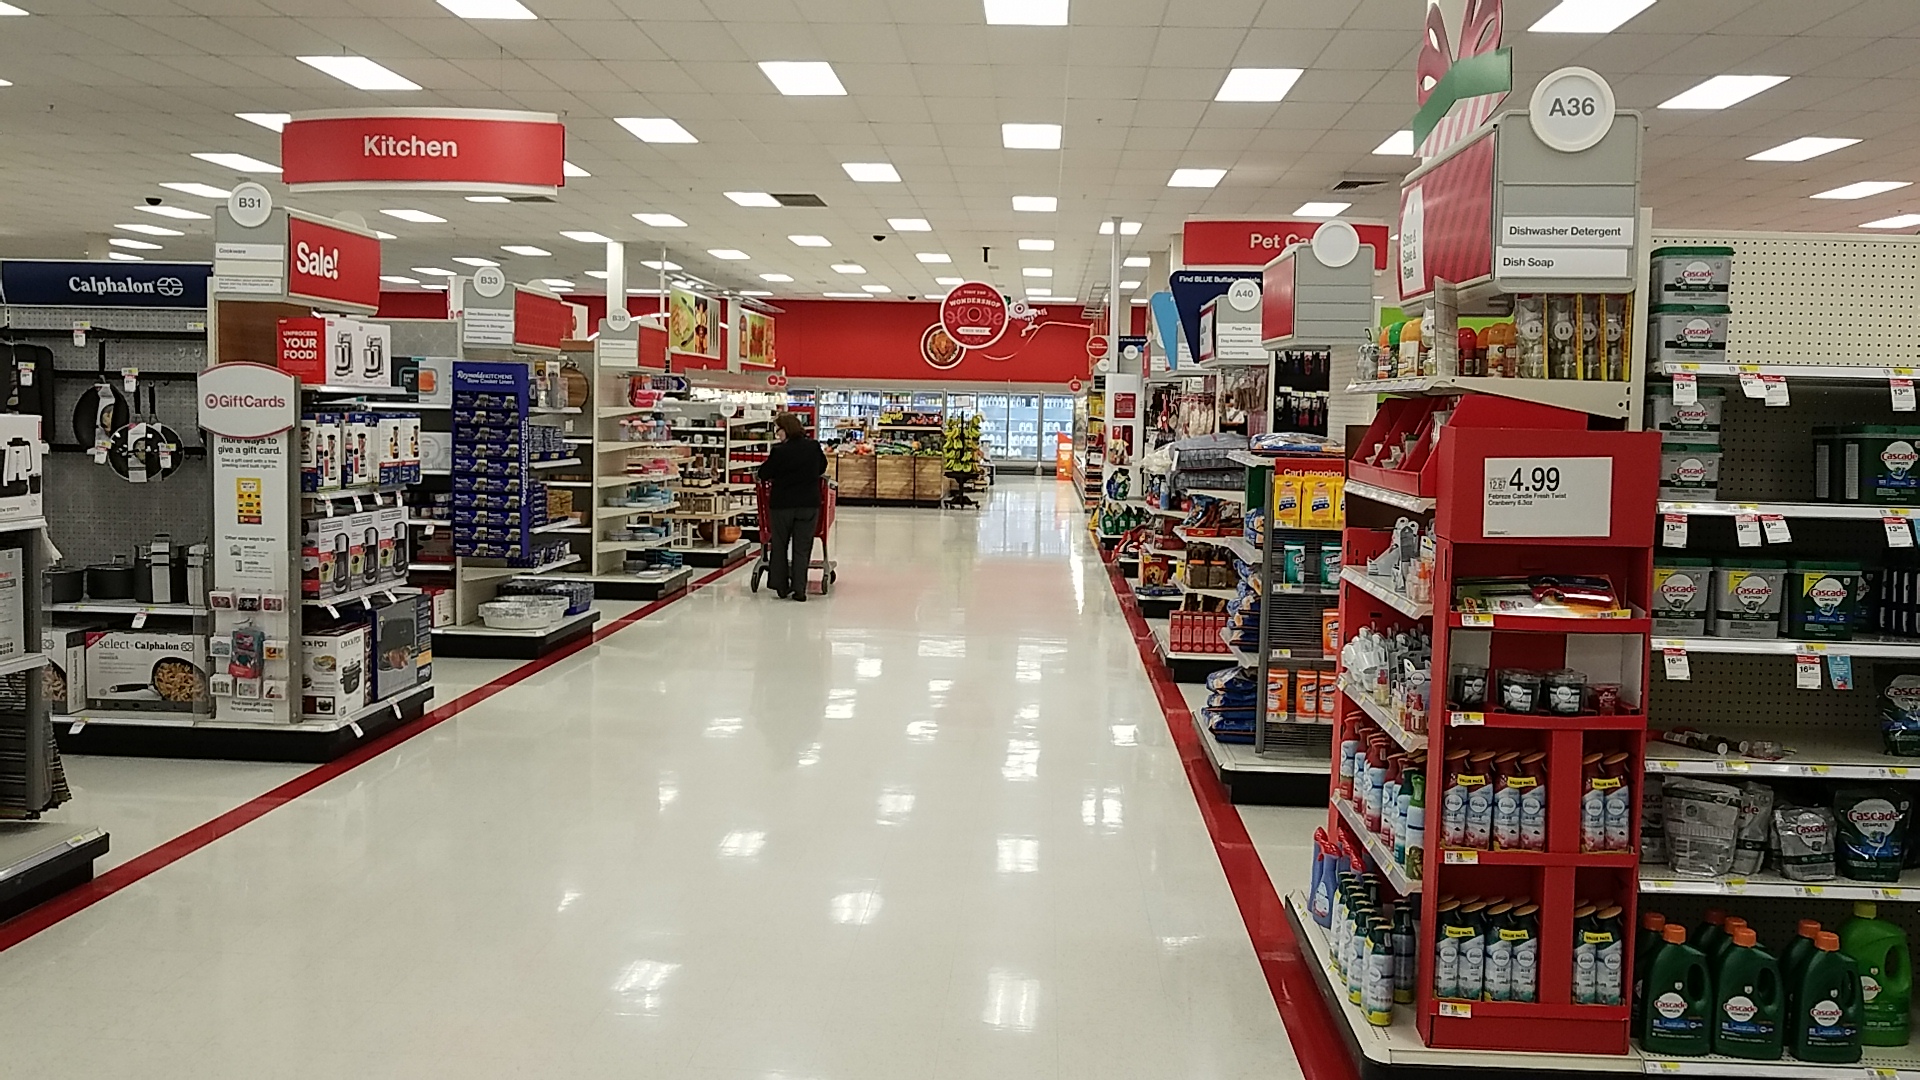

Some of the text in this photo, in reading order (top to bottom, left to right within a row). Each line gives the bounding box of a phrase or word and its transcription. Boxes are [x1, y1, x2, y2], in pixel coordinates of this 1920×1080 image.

[1548, 97, 1595, 116] A36
[364, 135, 457, 157] Kitchen
[238, 197, 261, 208] B31
[1509, 226, 1622, 238] Dishwasher Detergent
[1250, 233, 1313, 249] Pet Ca
[296, 241, 339, 280] Sale!
[1503, 257, 1554, 268] Dish Soap
[1682, 270, 1715, 278] Cascade
[480, 276, 498, 285] B33
[1178, 275, 1193, 283] Find
[1194, 275, 1213, 283] BLUE
[1214, 276, 1237, 284] Buffalo
[68, 276, 156, 296] Calphalon
[1235, 289, 1254, 298] A40
[948, 297, 1002, 308] WONDERSHOP
[612, 314, 626, 322] B35
[1682, 327, 1714, 335] Cascade
[282, 337, 318, 349] YOUR
[283, 349, 318, 360] FOOD!
[219, 394, 286, 408] GiftCards
[1676, 409, 1708, 417] Cascade
[244, 437, 266, 446] ways
[267, 436, 278, 445] to
[217, 445, 234, 455] give
[243, 446, 257, 456] gift
[258, 447, 282, 455] card.
[1882, 452, 1918, 460] Cascade
[1283, 468, 1343, 477] Cart stopping
[1677, 467, 1707, 475] Cascade
[1509, 467, 1560, 492] 4.99
[1489, 480, 1507, 490] 12.67
[1661, 584, 1697, 594] Cascade
[1735, 586, 1772, 596] Cascade
[1810, 588, 1847, 598] Cascade
[98, 638, 130, 650] select
[134, 641, 179, 651] Calphalon
[1848, 810, 1900, 822] Cascade
[1796, 824, 1829, 835] Cascade
[1655, 1000, 1687, 1009] Cascade
[1724, 1004, 1757, 1012] Cascade
[1811, 1008, 1842, 1016] Cascade
